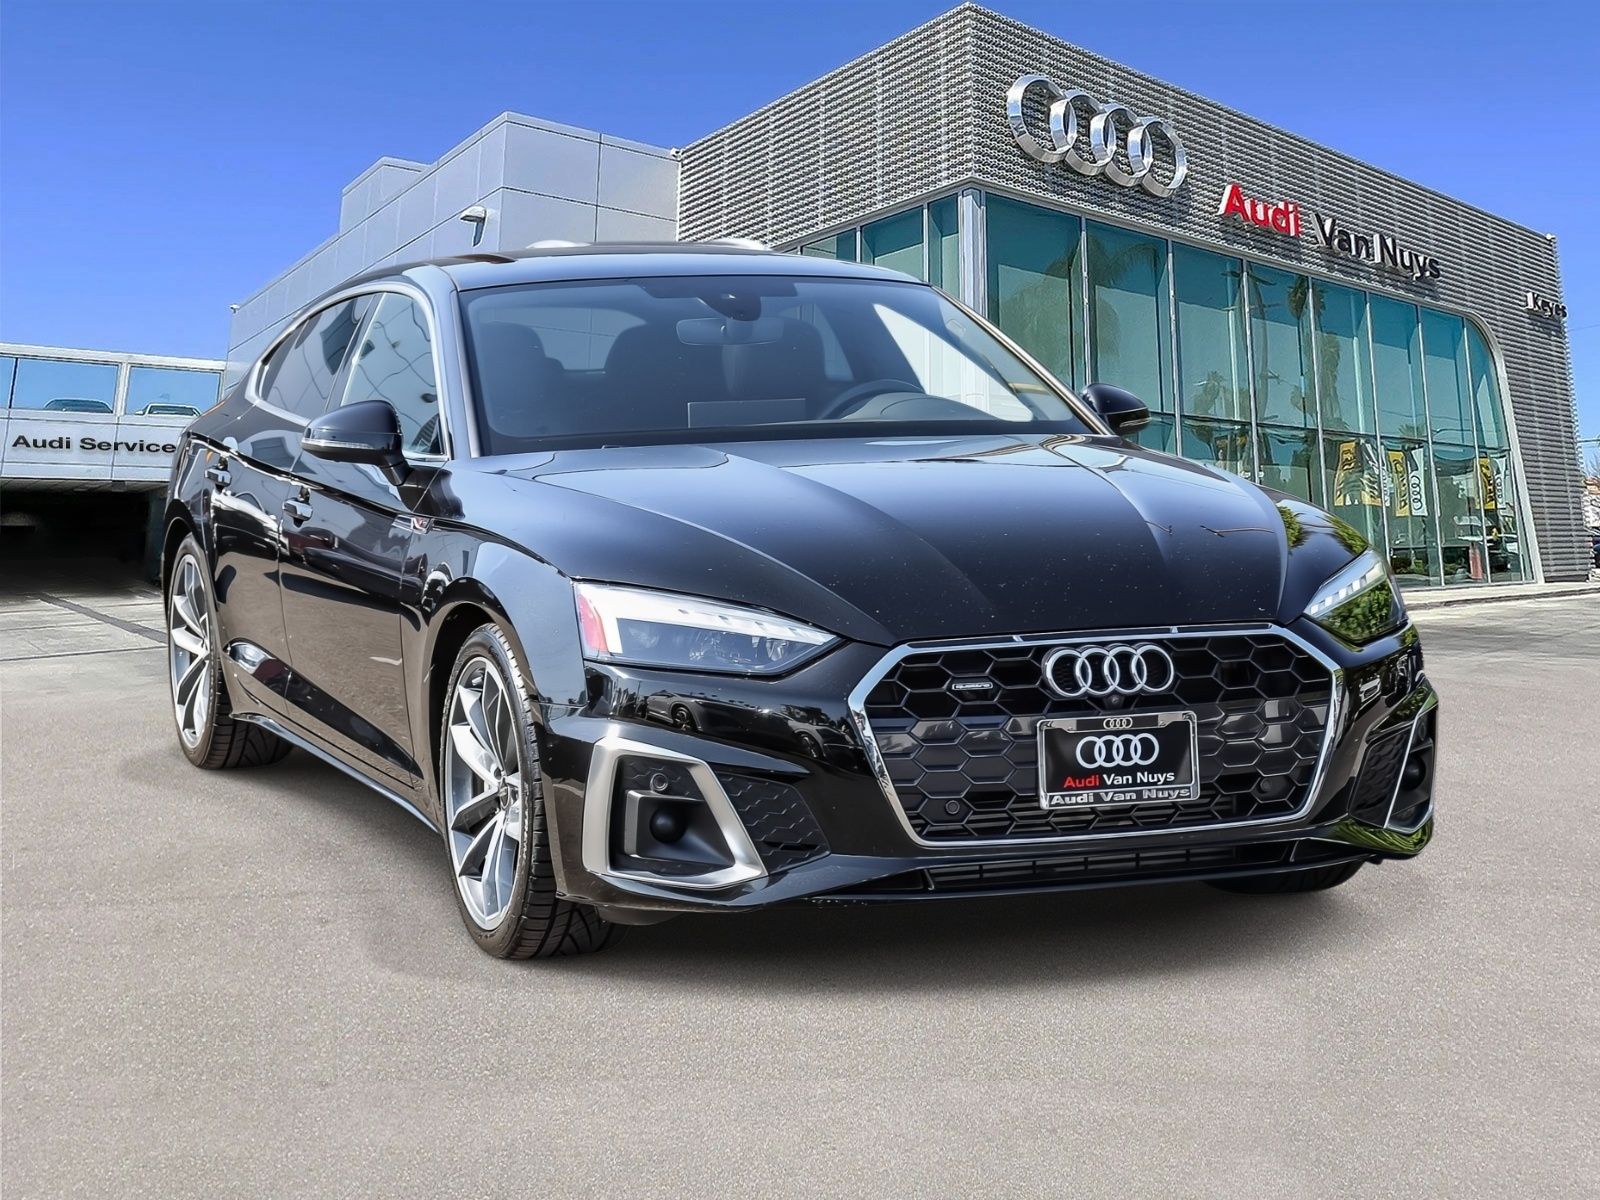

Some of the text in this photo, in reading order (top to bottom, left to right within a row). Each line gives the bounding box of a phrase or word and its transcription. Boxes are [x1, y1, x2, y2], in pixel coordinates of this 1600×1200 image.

[1217, 184, 1440, 280] Audi Van Nuys
[12, 435, 176, 453] Audi Service
[1063, 771, 1175, 788] Audi Van Nuys
[1051, 788, 1191, 804] Audi Van Nuys
